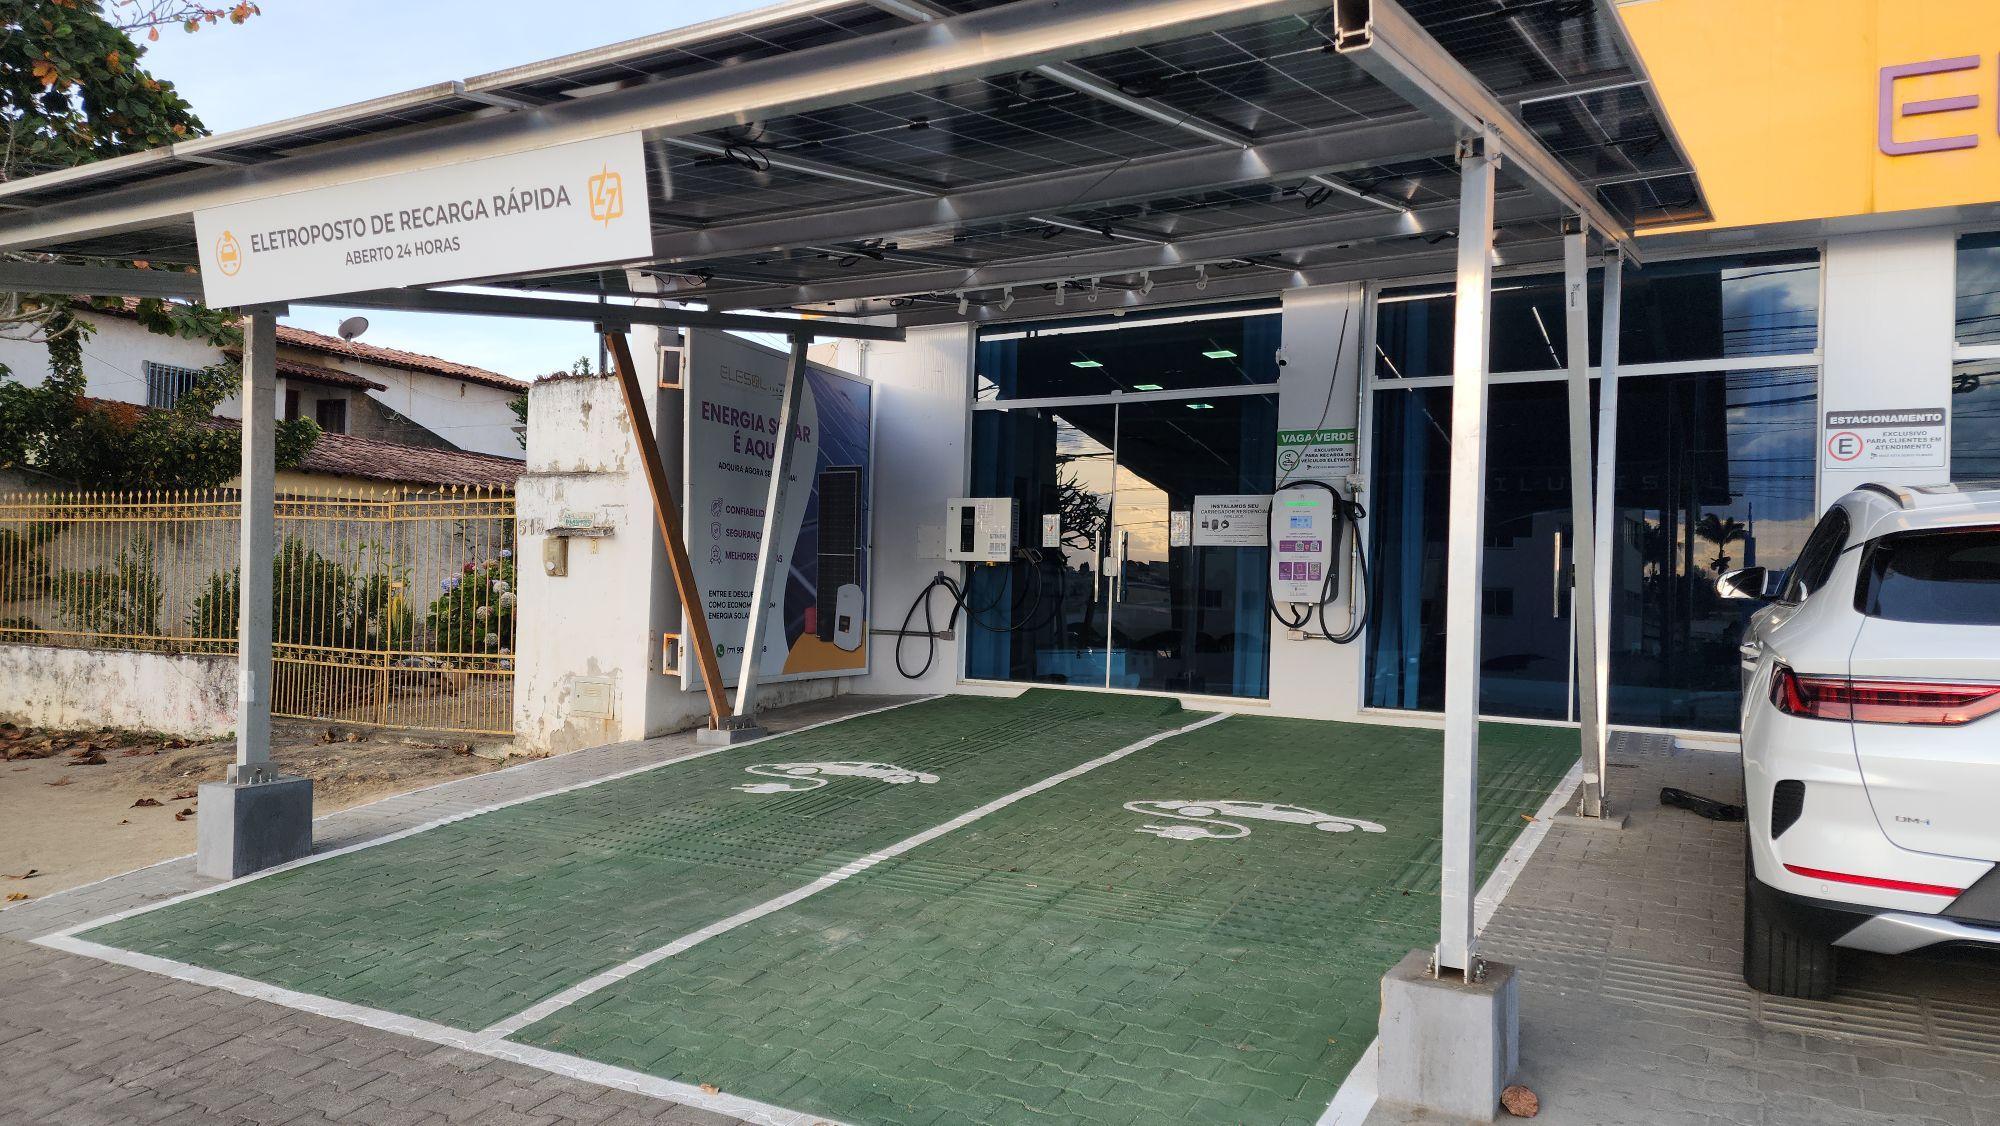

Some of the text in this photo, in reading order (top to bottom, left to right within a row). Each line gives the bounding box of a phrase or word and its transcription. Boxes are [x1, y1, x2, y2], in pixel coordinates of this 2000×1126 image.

[1878, 54, 2000, 156] E
[251, 185, 571, 253] ELETROPOSTO DE RECARGA RÁPIDA
[345, 236, 461, 266] ABERTO 24 HORAS
[701, 400, 811, 443] ENERGIA SAR
[1830, 413, 1942, 425] ESTACIONAMENTO
[1281, 432, 1354, 443] VAGA VERDE
[733, 430, 777, 460] É AQU
[1838, 438, 1853, 454] E
[718, 461, 743, 473] ADQUIRA
[745, 465, 764, 477] AGORA
[725, 505, 766, 518] CONFIABILID
[725, 550, 758, 561] MELHORES
[708, 590, 727, 598] ENTRE
[733, 590, 754, 598] DESCU
[708, 601, 752, 609] COMO ECONOM
[708, 612, 749, 620] ENERGIA SOLA
